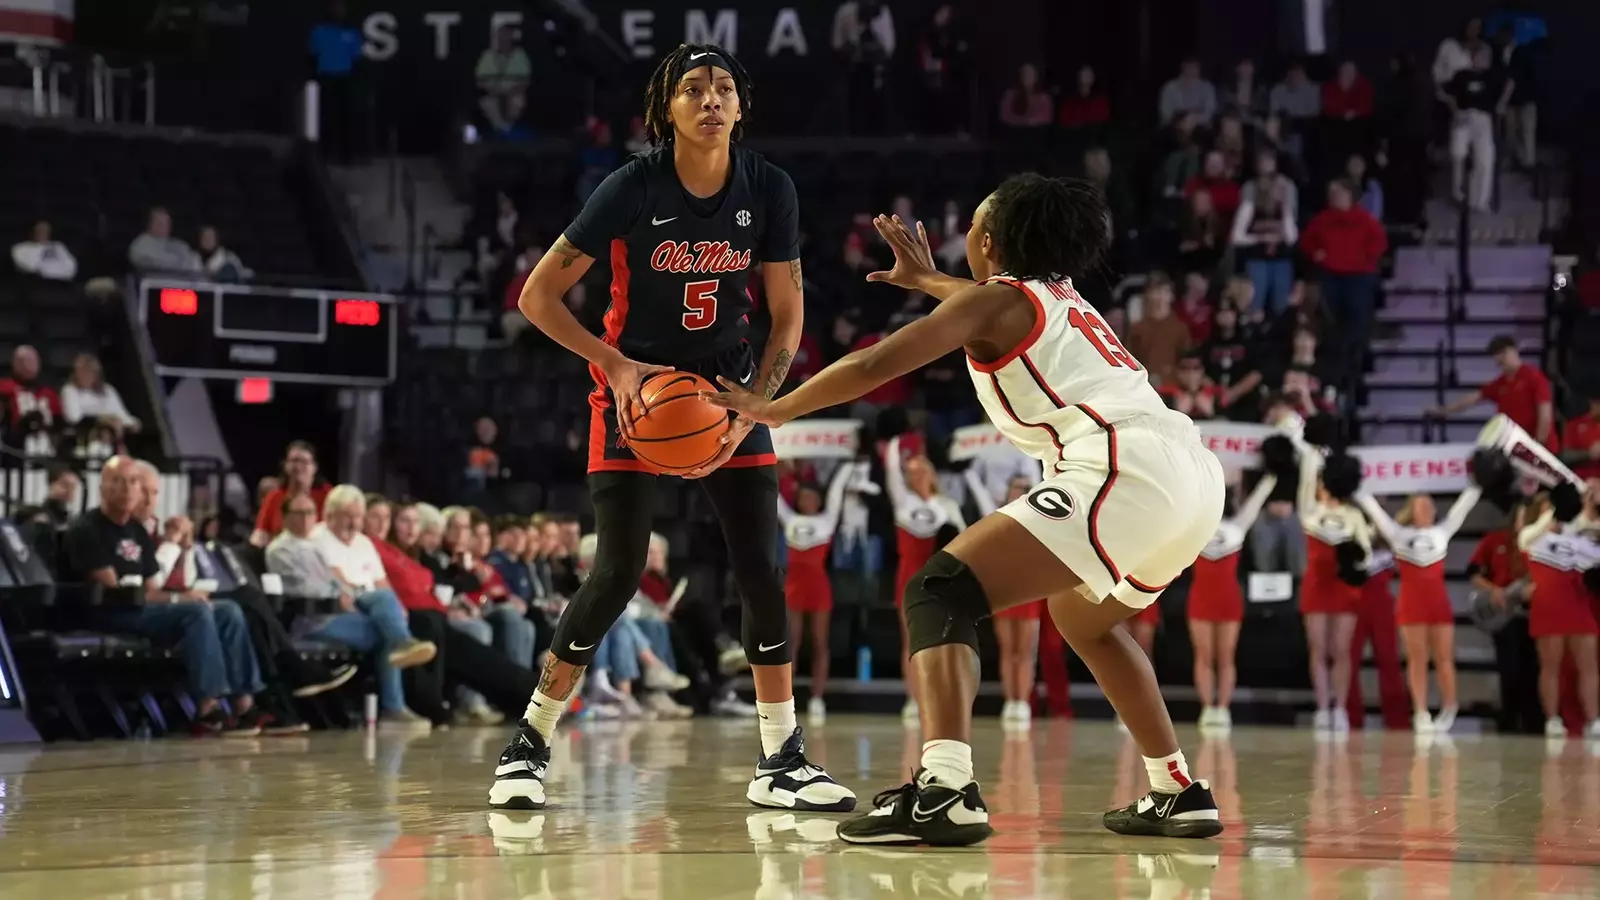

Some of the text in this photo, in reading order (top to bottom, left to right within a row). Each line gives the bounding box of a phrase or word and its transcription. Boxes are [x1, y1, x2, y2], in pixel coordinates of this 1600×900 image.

[735, 209, 752, 227] SEC
[650, 240, 752, 273] Ole Miss
[681, 278, 720, 331] 5
[1067, 307, 1138, 372] 13
[1026, 486, 1074, 519] G
